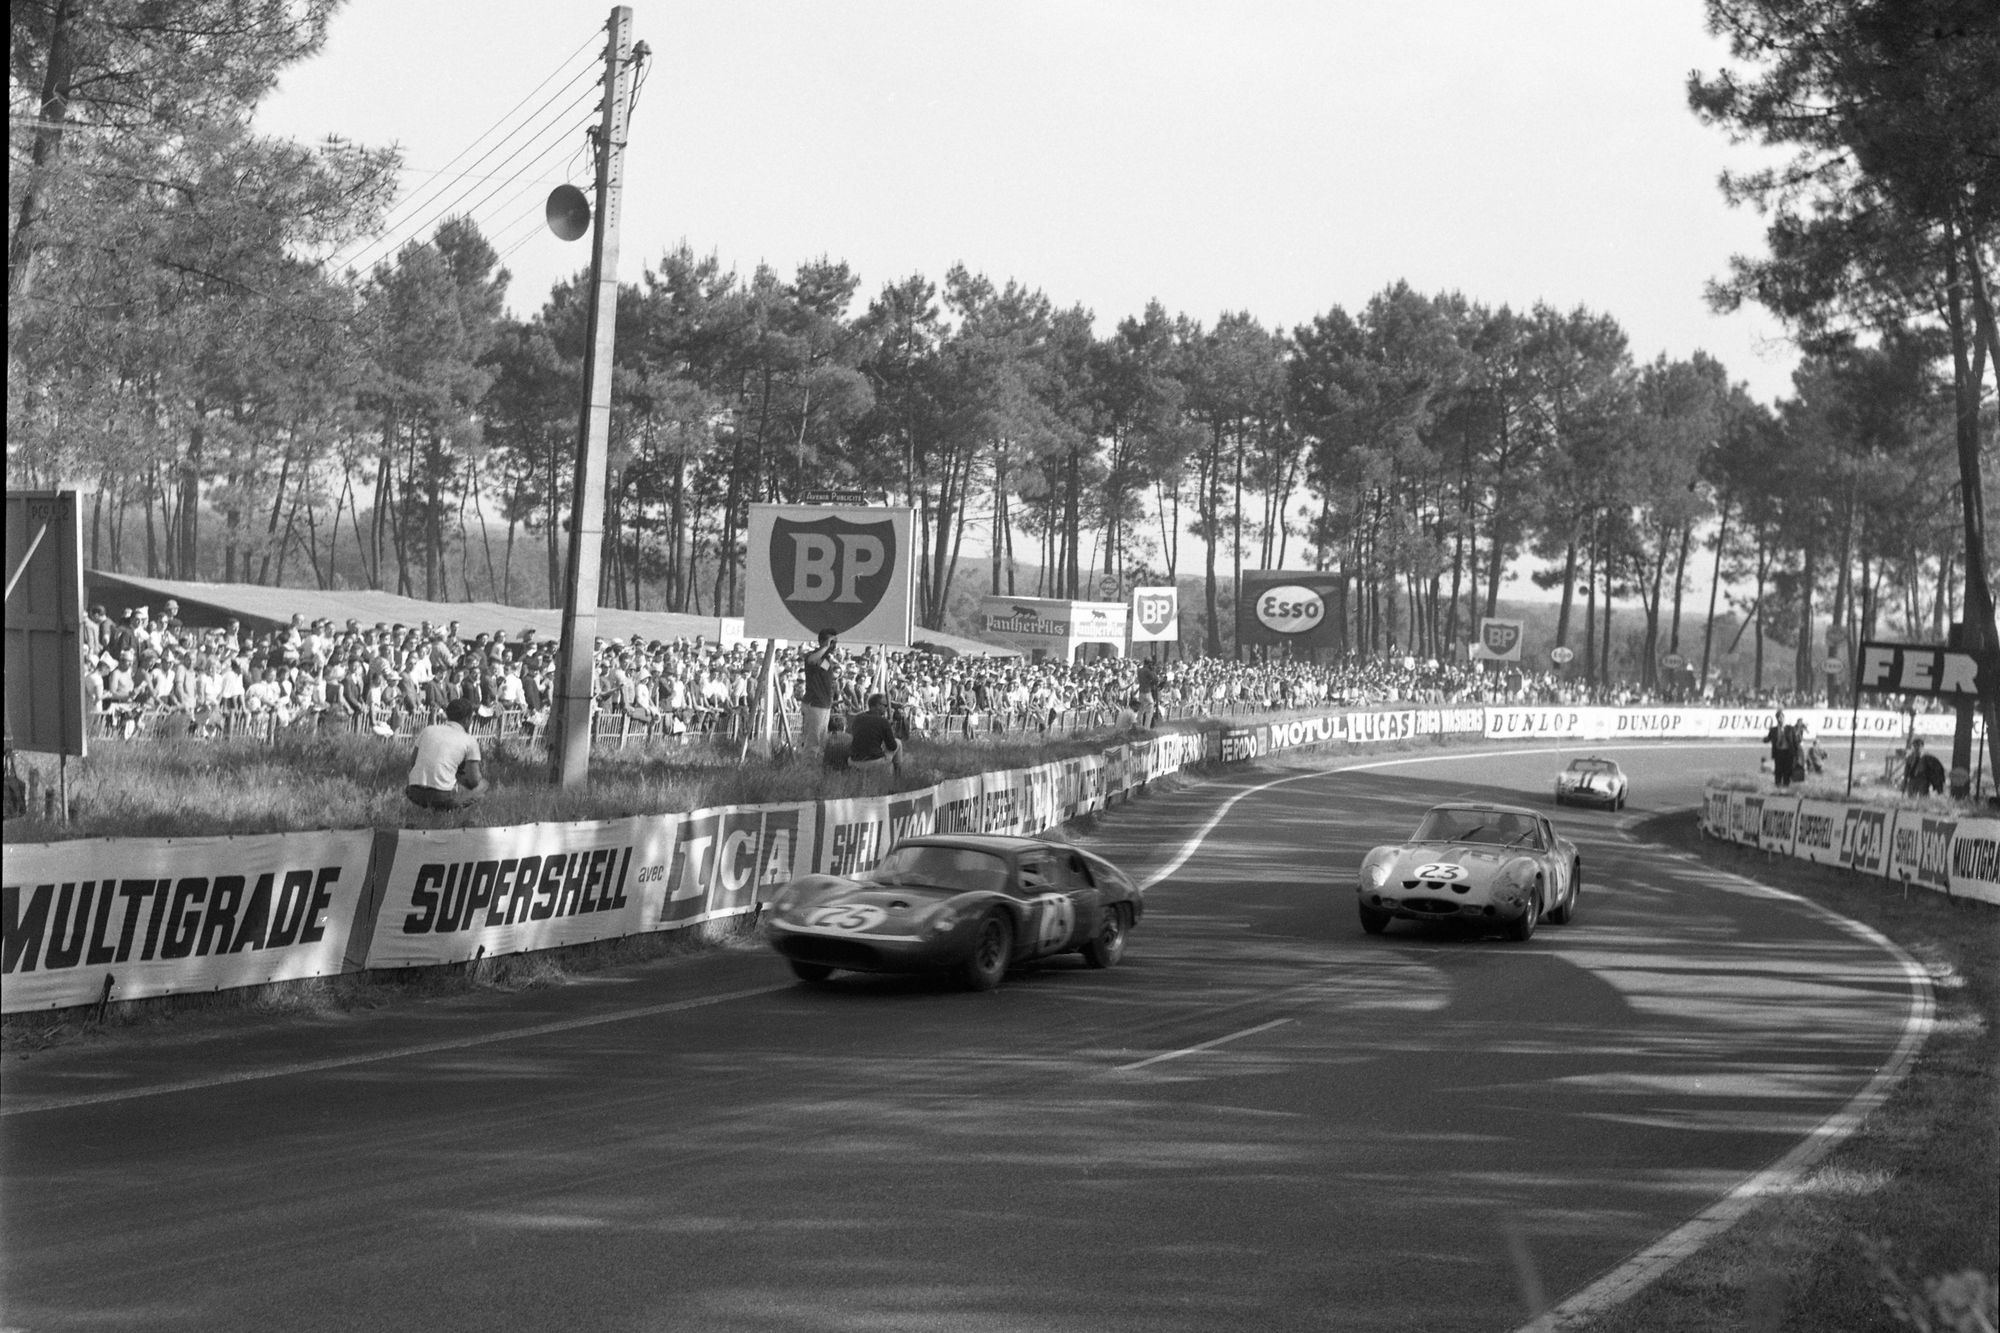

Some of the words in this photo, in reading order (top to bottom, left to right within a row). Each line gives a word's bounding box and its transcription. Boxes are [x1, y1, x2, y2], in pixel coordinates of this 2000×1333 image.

[784, 533, 885, 603] BP
[1142, 600, 1170, 624] BP
[1489, 628, 1516, 647] BP
[1271, 716, 1348, 749] MOTUL
[1354, 712, 1410, 741] LUCAS
[1492, 713, 1579, 732] DUNLOP
[1617, 714, 1681, 731] DUNLOP
[1222, 735, 1257, 762] FERODO
[829, 821, 883, 876] SHELL
[1842, 818, 1882, 860] ICA
[1420, 864, 1459, 880] 23
[1952, 837, 2000, 884] MULTIGRA
[403, 847, 633, 934] SUPERSHELL
[638, 864, 663, 883] avec
[670, 829, 793, 902] ICA
[1, 867, 342, 974] MULTIGRADE
[814, 905, 880, 930] 25
